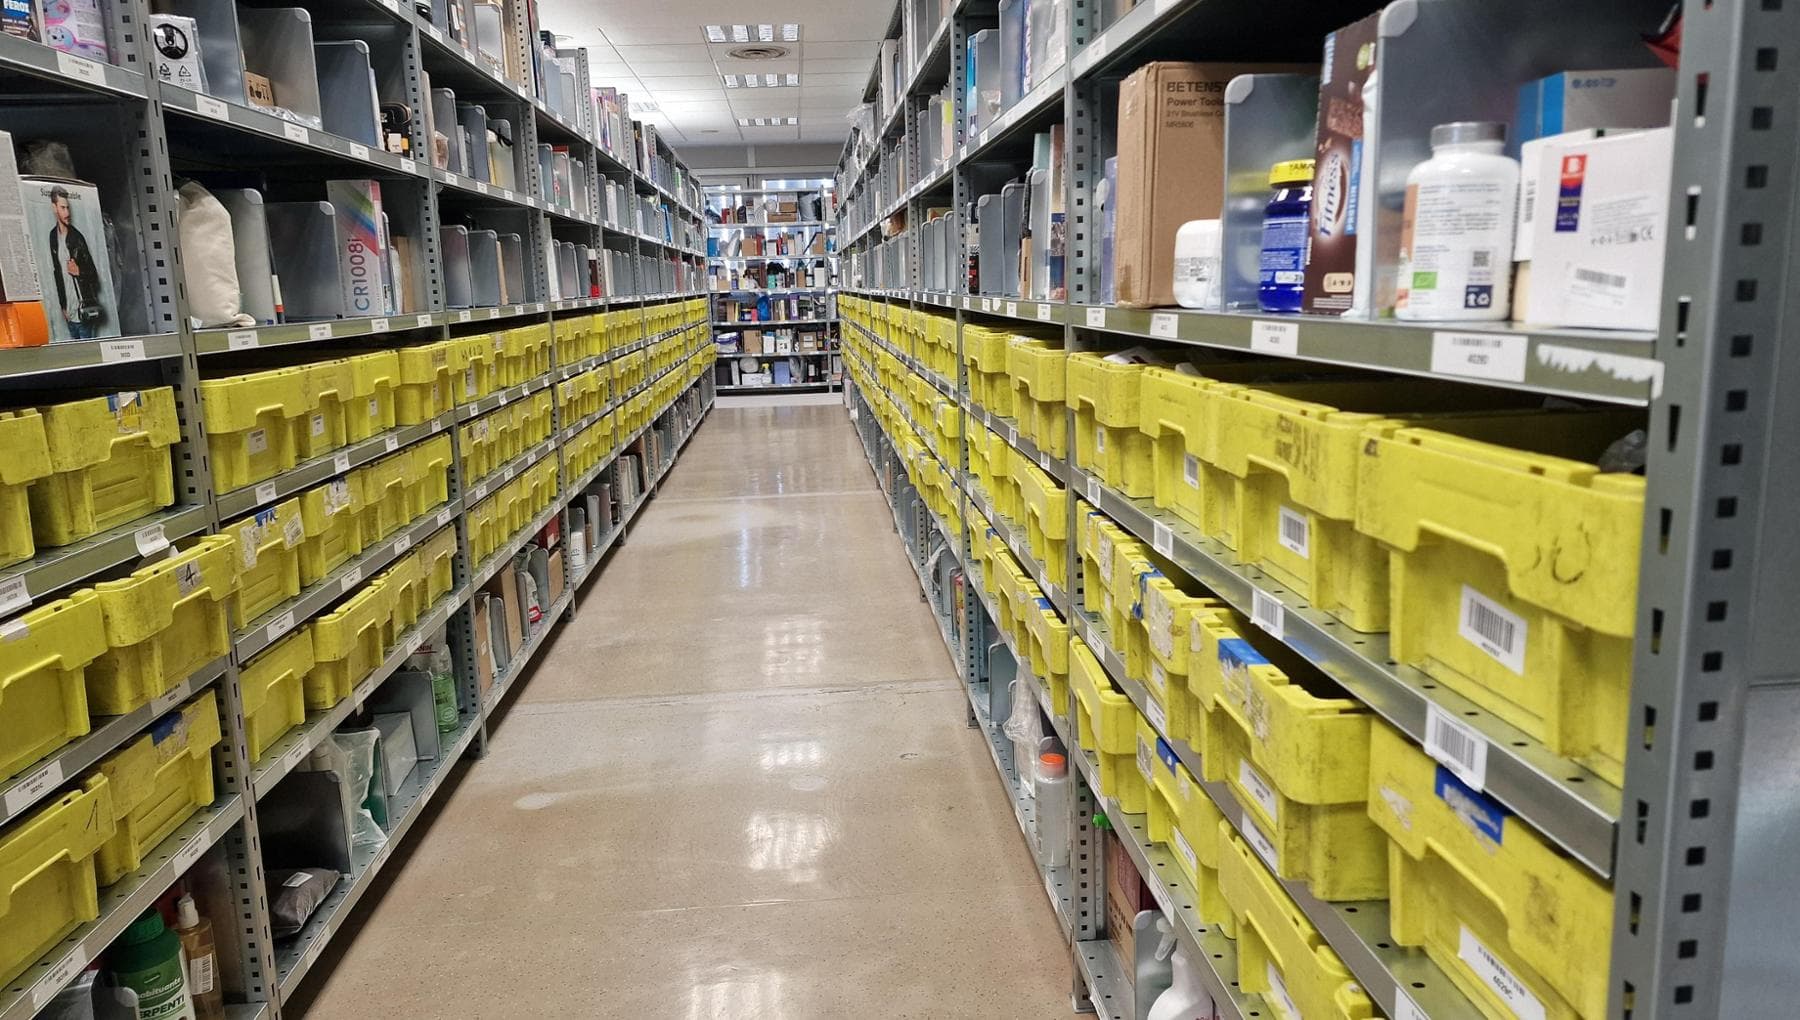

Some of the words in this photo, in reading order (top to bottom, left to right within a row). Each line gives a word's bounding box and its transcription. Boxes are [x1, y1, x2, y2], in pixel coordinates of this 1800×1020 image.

[1167, 97, 1198, 106] Power
[347, 238, 370, 311] CR1008i
[184, 564, 197, 586] 4
[138, 976, 183, 999] abituante
